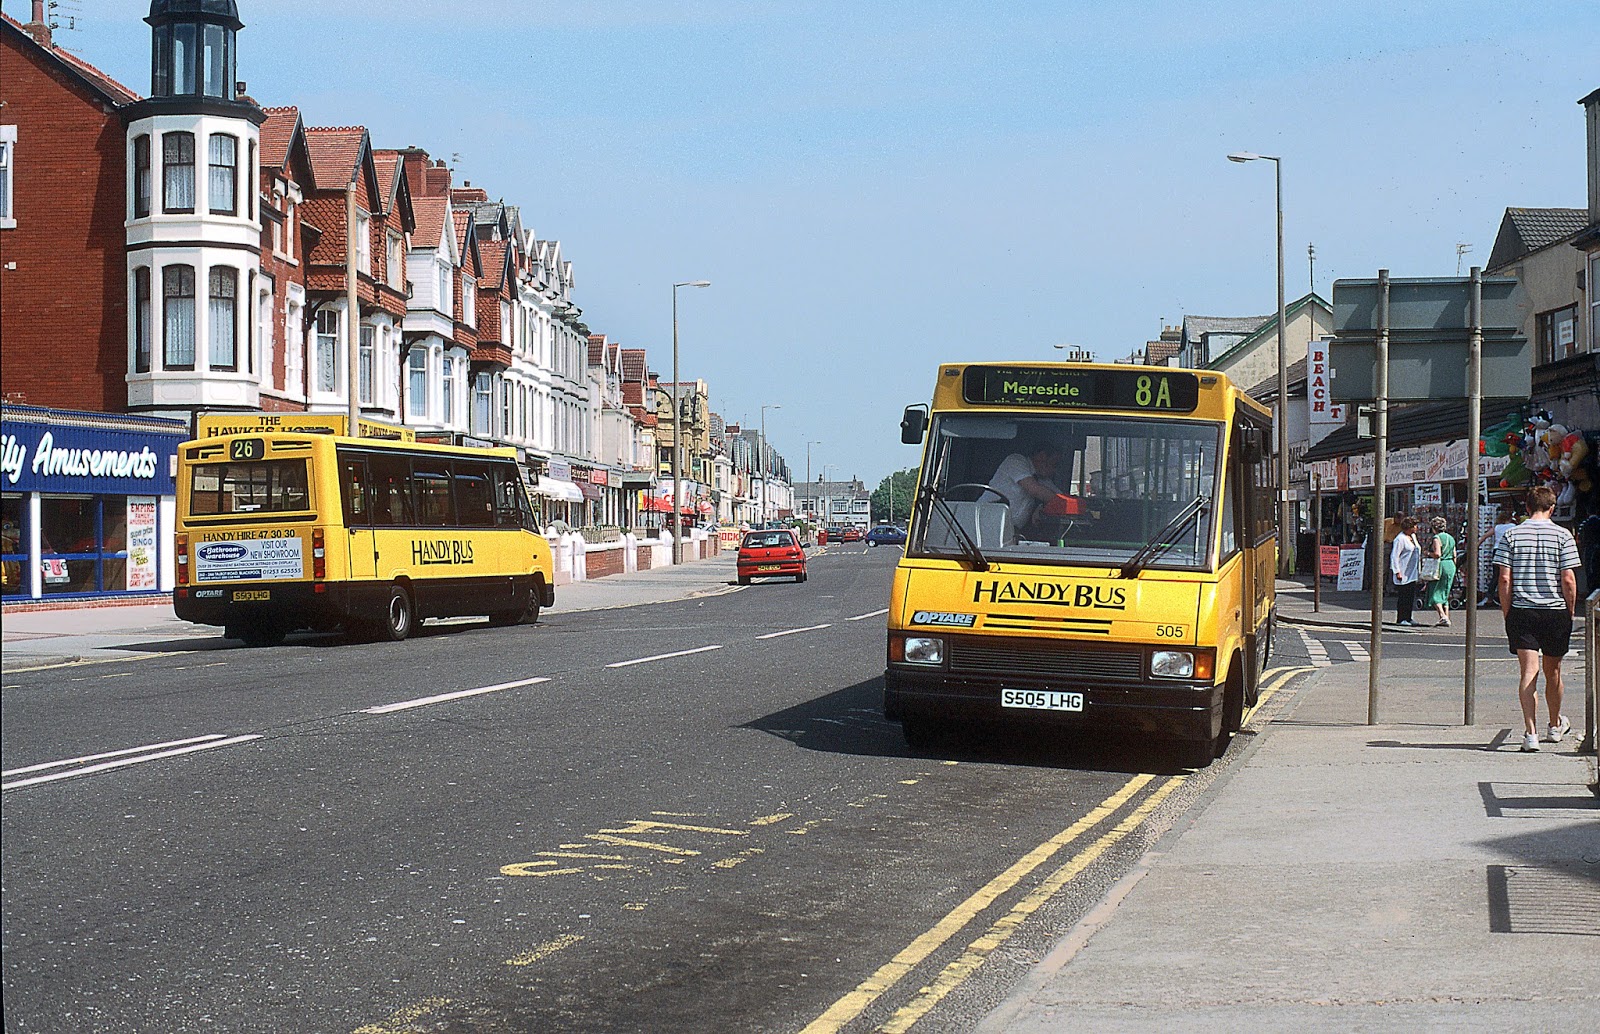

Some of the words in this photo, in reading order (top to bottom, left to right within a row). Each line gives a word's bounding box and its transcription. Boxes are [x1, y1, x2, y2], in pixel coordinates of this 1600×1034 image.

[1003, 381, 1079, 396] Mereside
[1312, 351, 1325, 412] BEACH
[1135, 375, 1171, 408] 8A
[259, 416, 281, 425] THE
[32, 431, 158, 479] Amusements
[234, 440, 253, 458] 26
[130, 502, 155, 512] EMPIRE
[132, 538, 153, 547] BINGO
[203, 532, 236, 542] HANDY
[237, 531, 256, 540] HIRE
[258, 530, 268, 539] 47
[271, 530, 281, 538] 30
[284, 529, 295, 538] 30
[260, 541, 274, 549] VISIT
[274, 540, 288, 549] OUR
[250, 550, 263, 560] NEW
[264, 549, 299, 559] SHOWROOM
[195, 590, 223, 598] OPTARE
[973, 580, 1070, 606] HANDY
[1073, 584, 1126, 609] BUS
[914, 611, 974, 626] OPTARE
[1155, 625, 1184, 638] 505
[1004, 691, 1046, 707] S505
[1050, 693, 1082, 709] LHG
